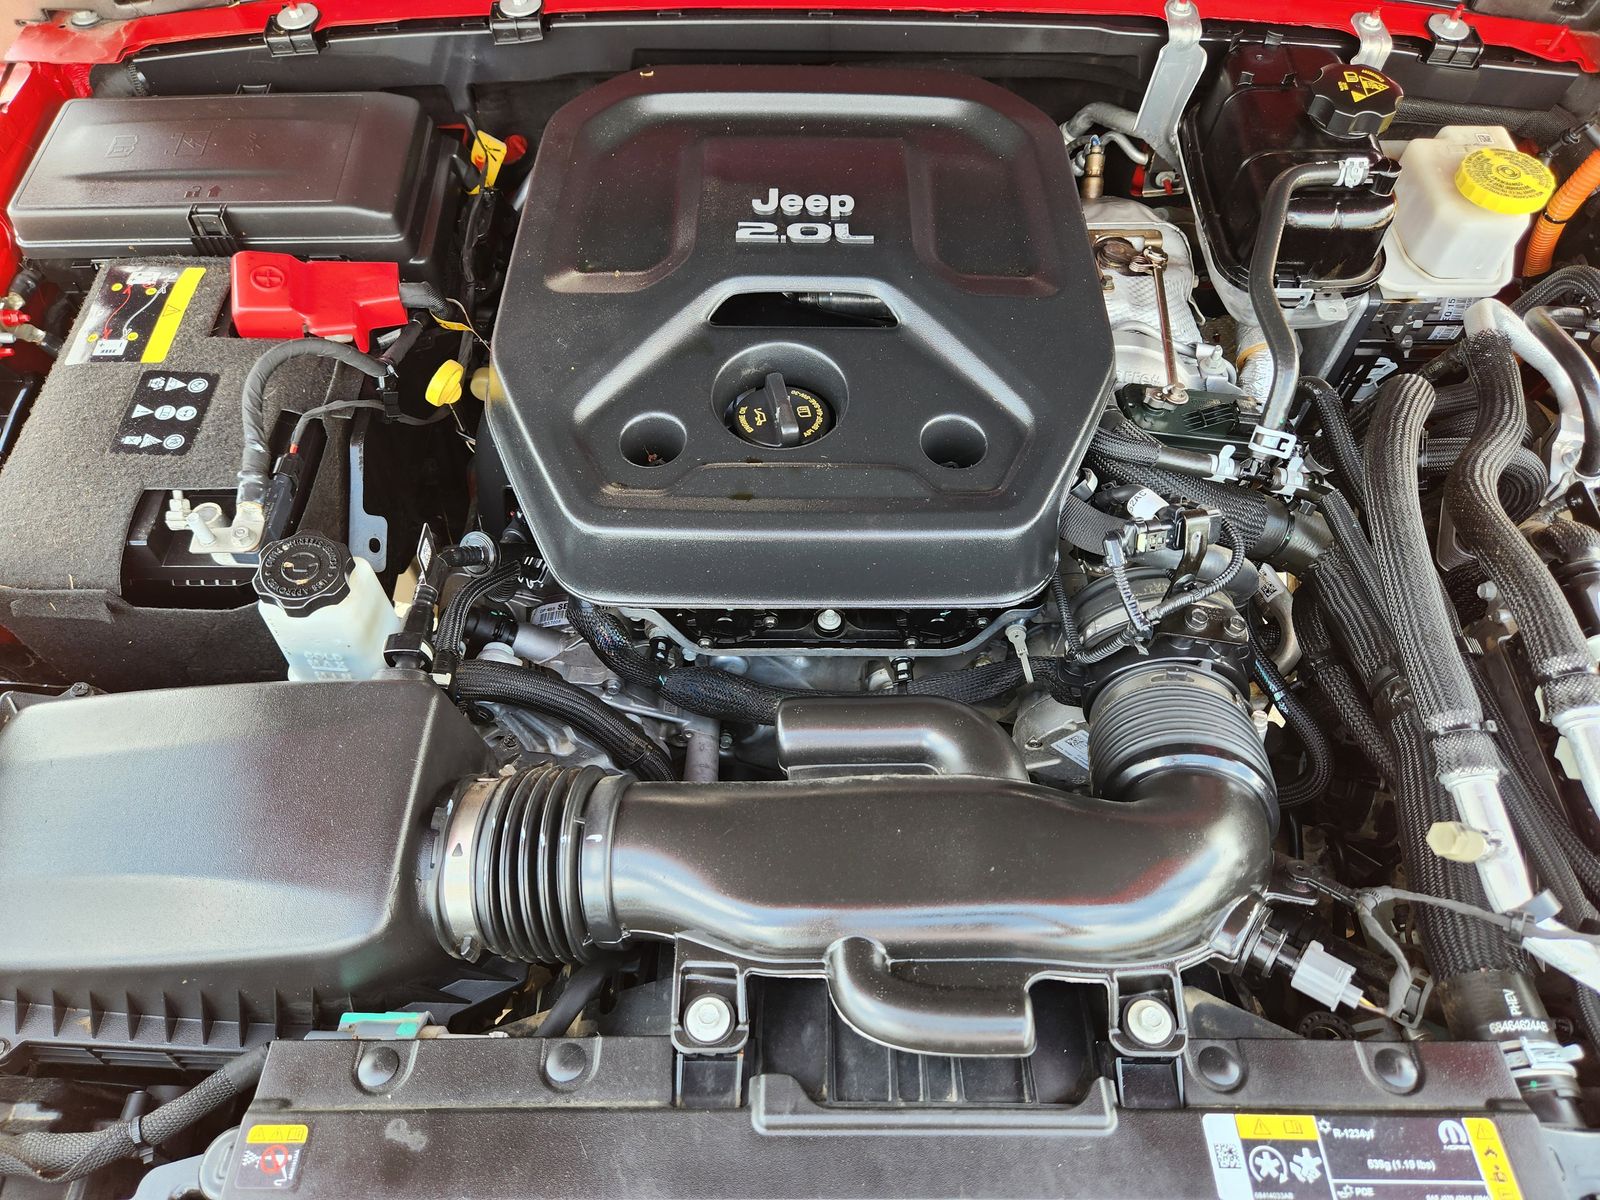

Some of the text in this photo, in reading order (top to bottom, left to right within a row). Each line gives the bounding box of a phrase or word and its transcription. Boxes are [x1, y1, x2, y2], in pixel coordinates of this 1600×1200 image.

[752, 188, 855, 220] Jeep
[736, 222, 874, 244] 2.0L
[1502, 988, 1523, 1017] PHEV
[1333, 1128, 1375, 1141] R-1234yf
